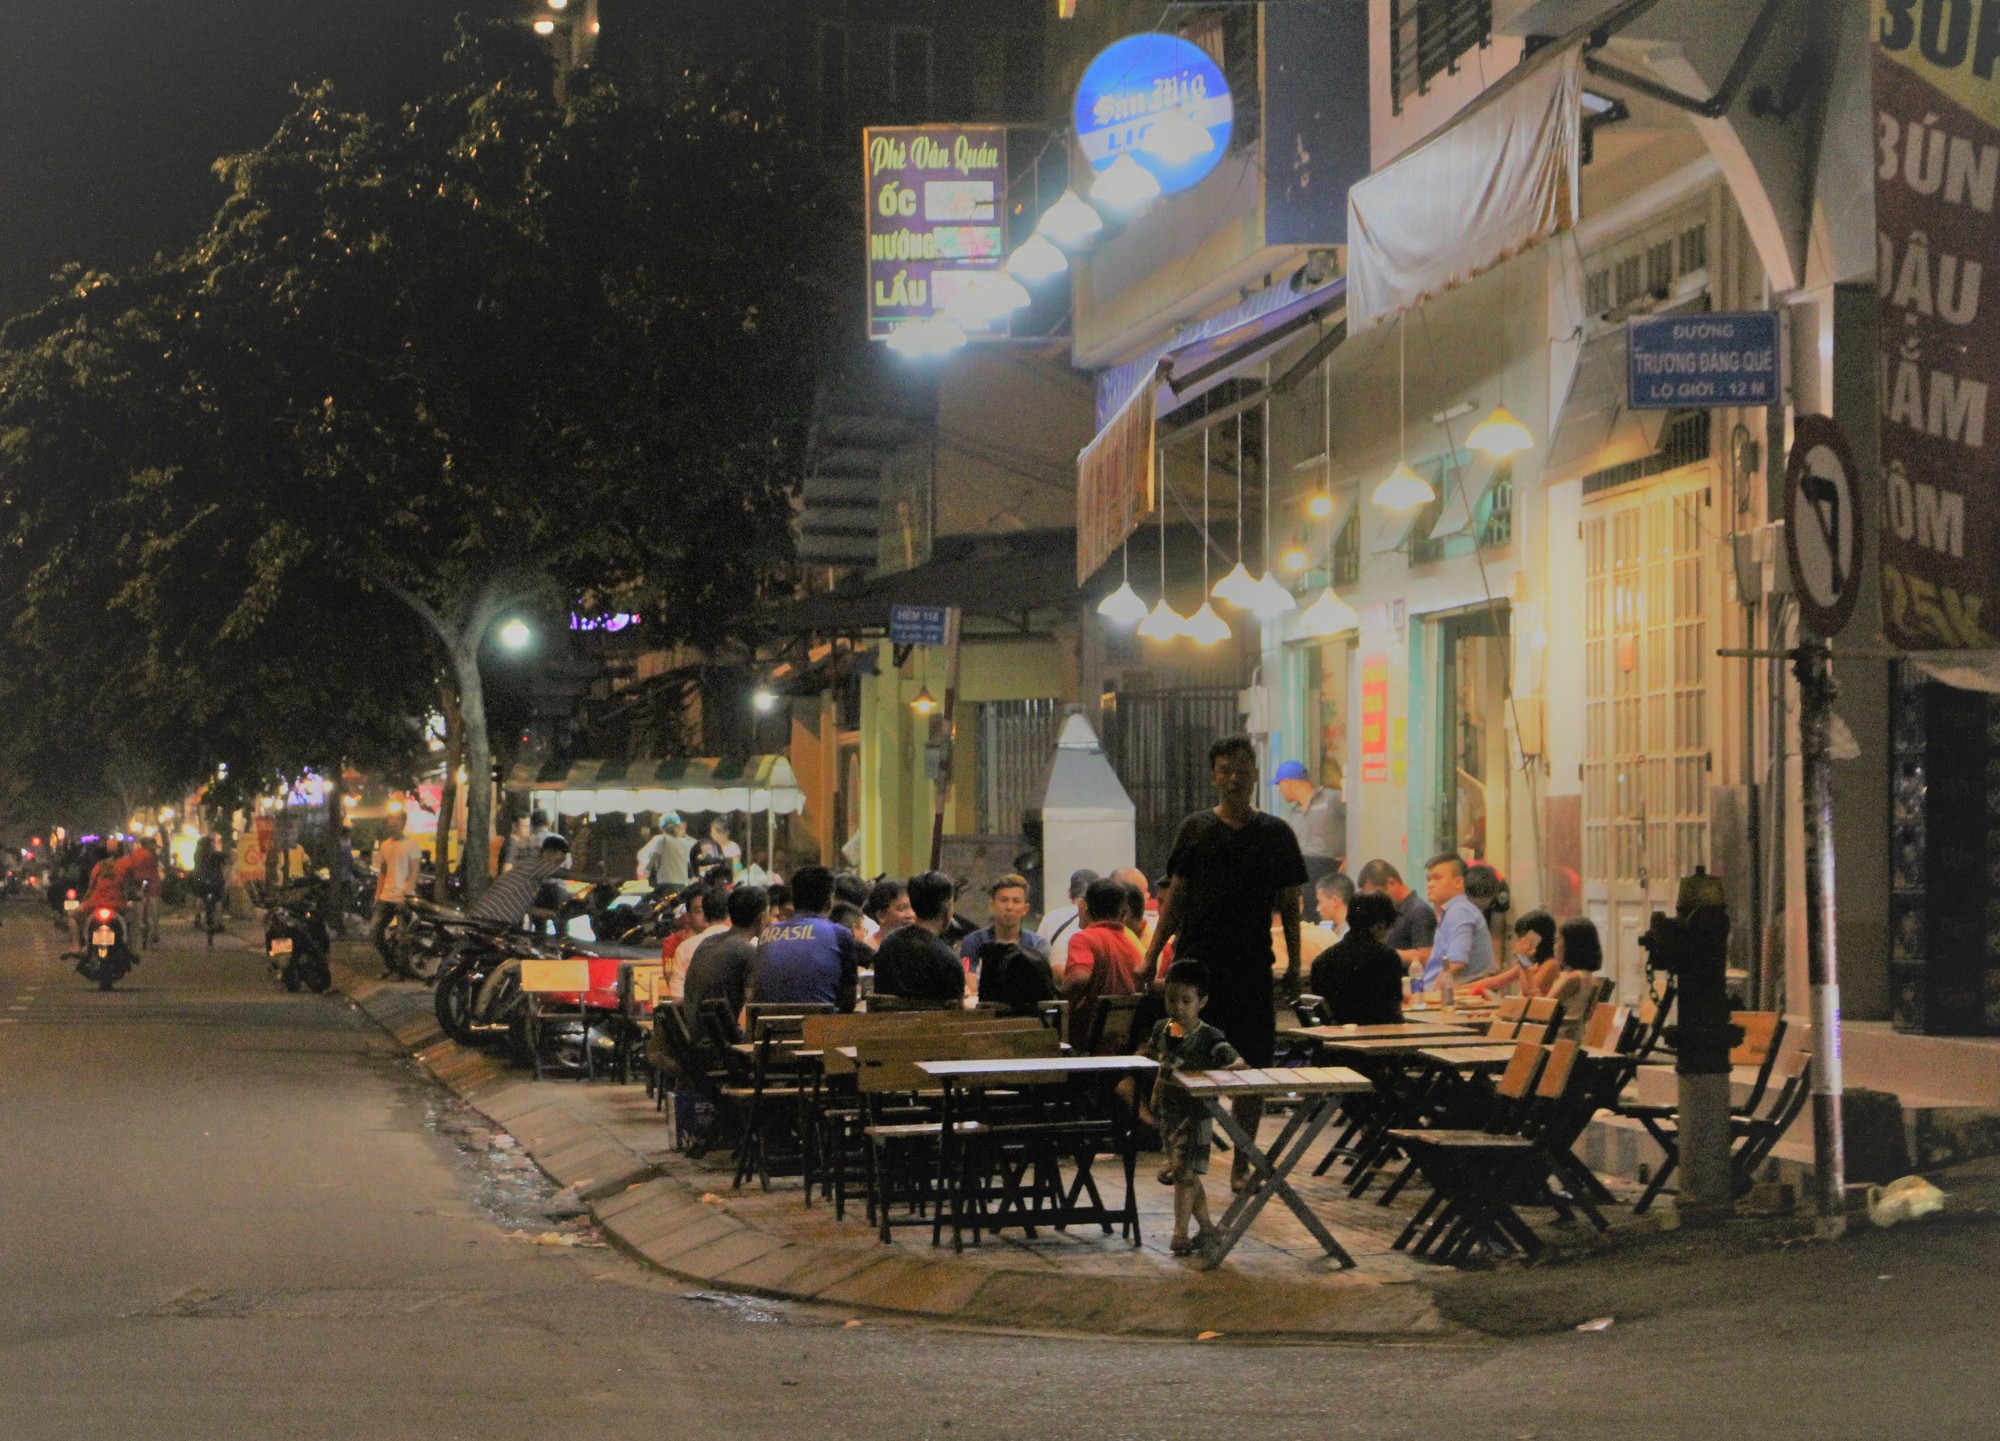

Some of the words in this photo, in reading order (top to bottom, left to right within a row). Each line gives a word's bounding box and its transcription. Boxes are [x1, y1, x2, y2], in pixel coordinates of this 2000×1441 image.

[1152, 70, 1207, 110] Mig
[954, 135, 999, 176] Quán
[878, 181, 918, 217] ỐC
[1729, 383, 1746, 396] 12
[1881, 337, 1988, 449] ẮM
[1882, 459, 1964, 558] ÔM
[760, 924, 816, 945] BRASIL
